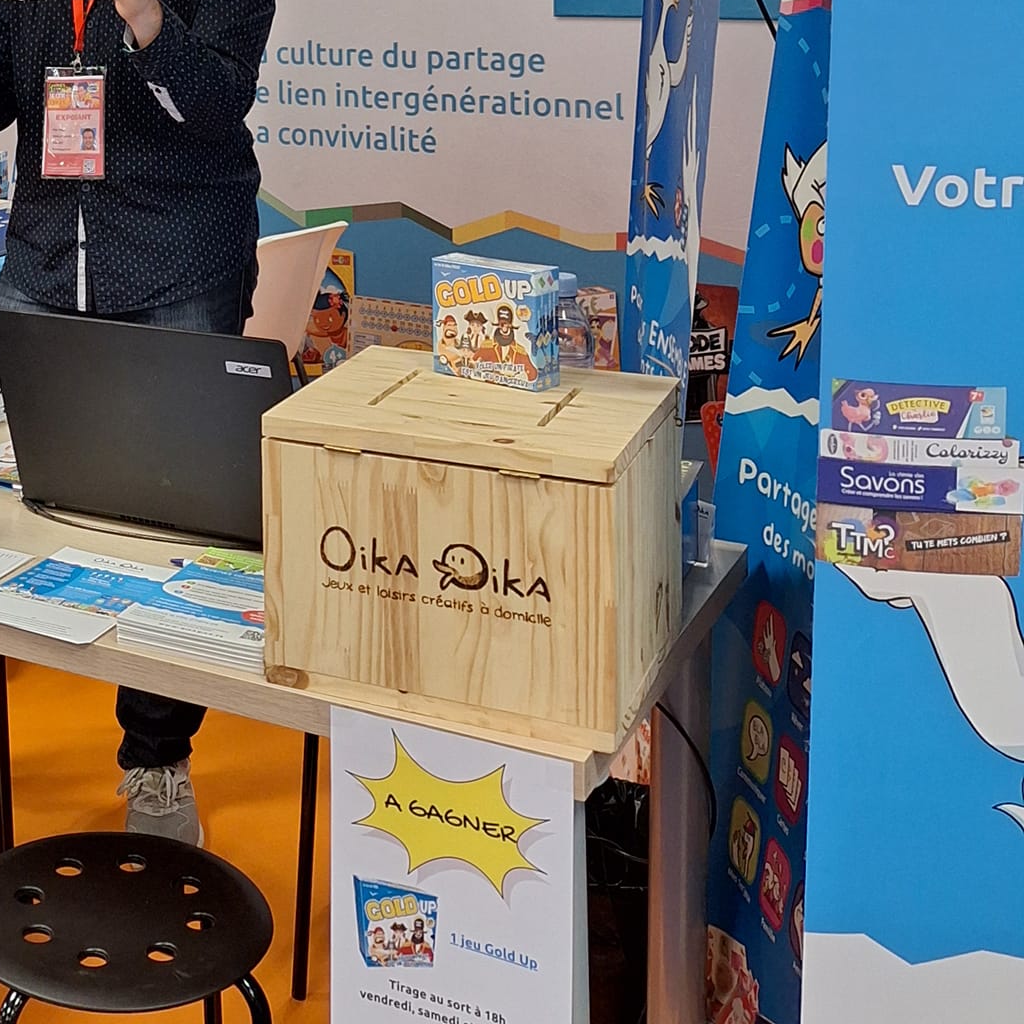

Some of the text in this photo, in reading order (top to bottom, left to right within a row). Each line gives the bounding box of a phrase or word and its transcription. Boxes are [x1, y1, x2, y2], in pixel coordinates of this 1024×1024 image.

[276, 40, 374, 67] culture
[382, 42, 417, 70] du
[427, 45, 546, 77] partage
[256, 80, 624, 121] e lien intergénérationnel
[256, 121, 438, 154] a convivialité
[891, 163, 1024, 210] Votr
[435, 273, 532, 308] GOLD UP
[690, 333, 721, 354] ODE
[234, 364, 262, 375] acer
[688, 353, 726, 371] AMES
[891, 401, 945, 412] DETECTIVE
[926, 442, 1008, 464] Colorizzy
[738, 457, 817, 534] Partage
[840, 466, 925, 494] Savons
[762, 522, 789, 558] des
[911, 532, 1007, 550] TU TE METS COMBIEN ?
[321, 576, 552, 627] Jeux et loisirs créatifs à domicile
[384, 793, 519, 845] A GAGNER
[365, 894, 437, 922] GOLD UP
[450, 932, 539, 972] 1 jeu Gold Up
[359, 989, 415, 1015] vendredi,
[389, 979, 427, 999] Tirage
[429, 993, 444, 1005] au
[447, 999, 472, 1015] sort
[474, 1005, 481, 1018] à
